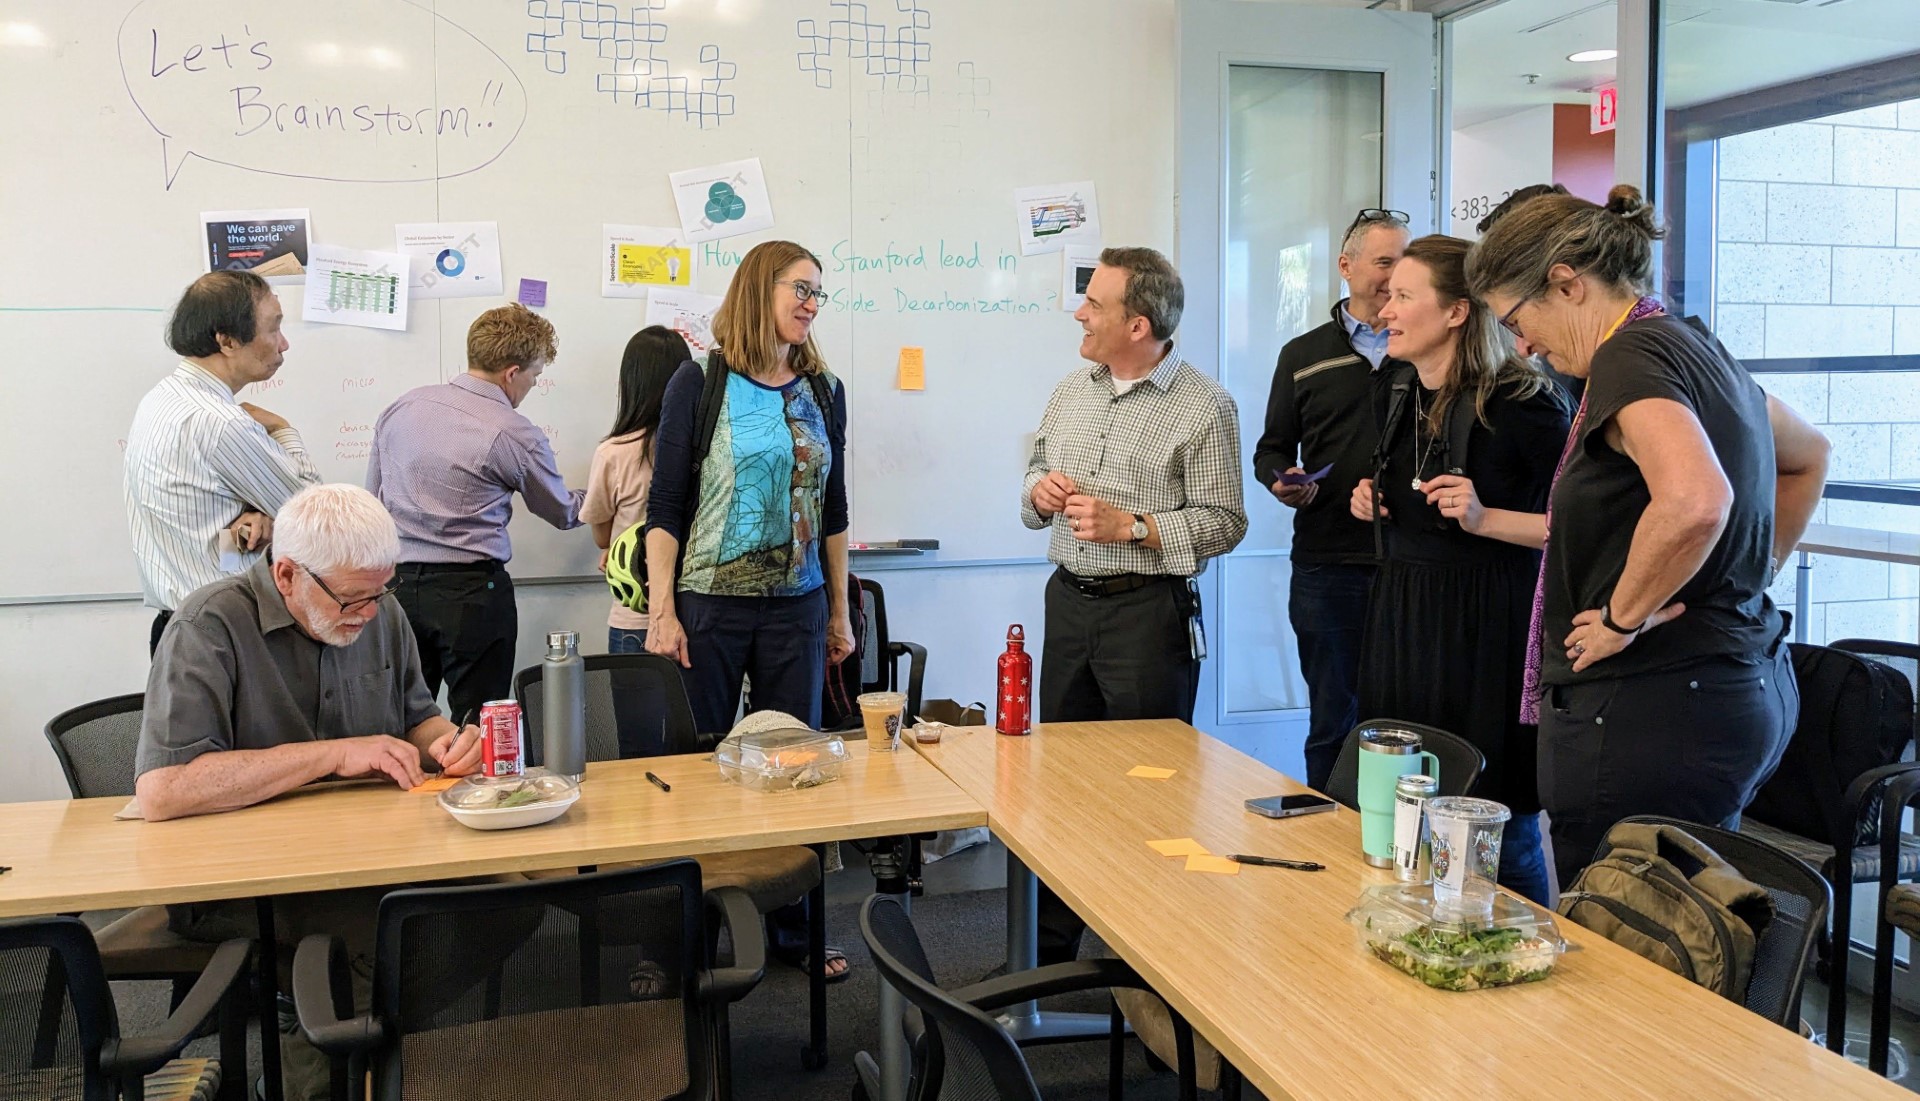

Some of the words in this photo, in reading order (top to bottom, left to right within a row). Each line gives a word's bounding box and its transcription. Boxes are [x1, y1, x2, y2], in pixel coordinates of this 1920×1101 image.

[152, 24, 273, 78] Let's
[229, 80, 504, 138] Brainstorm!!
[1600, 88, 1616, 126] EX
[226, 224, 246, 234] We
[247, 224, 268, 233] can
[270, 223, 296, 233] save
[227, 234, 246, 244] the
[248, 232, 283, 243] world.
[420, 232, 481, 289] DFT
[832, 239, 927, 273] Stanford
[940, 239, 984, 269] lead
[998, 248, 1017, 275] in
[832, 287, 880, 313] Side
[342, 377, 375, 392] micro
[537, 379, 556, 396] ega
